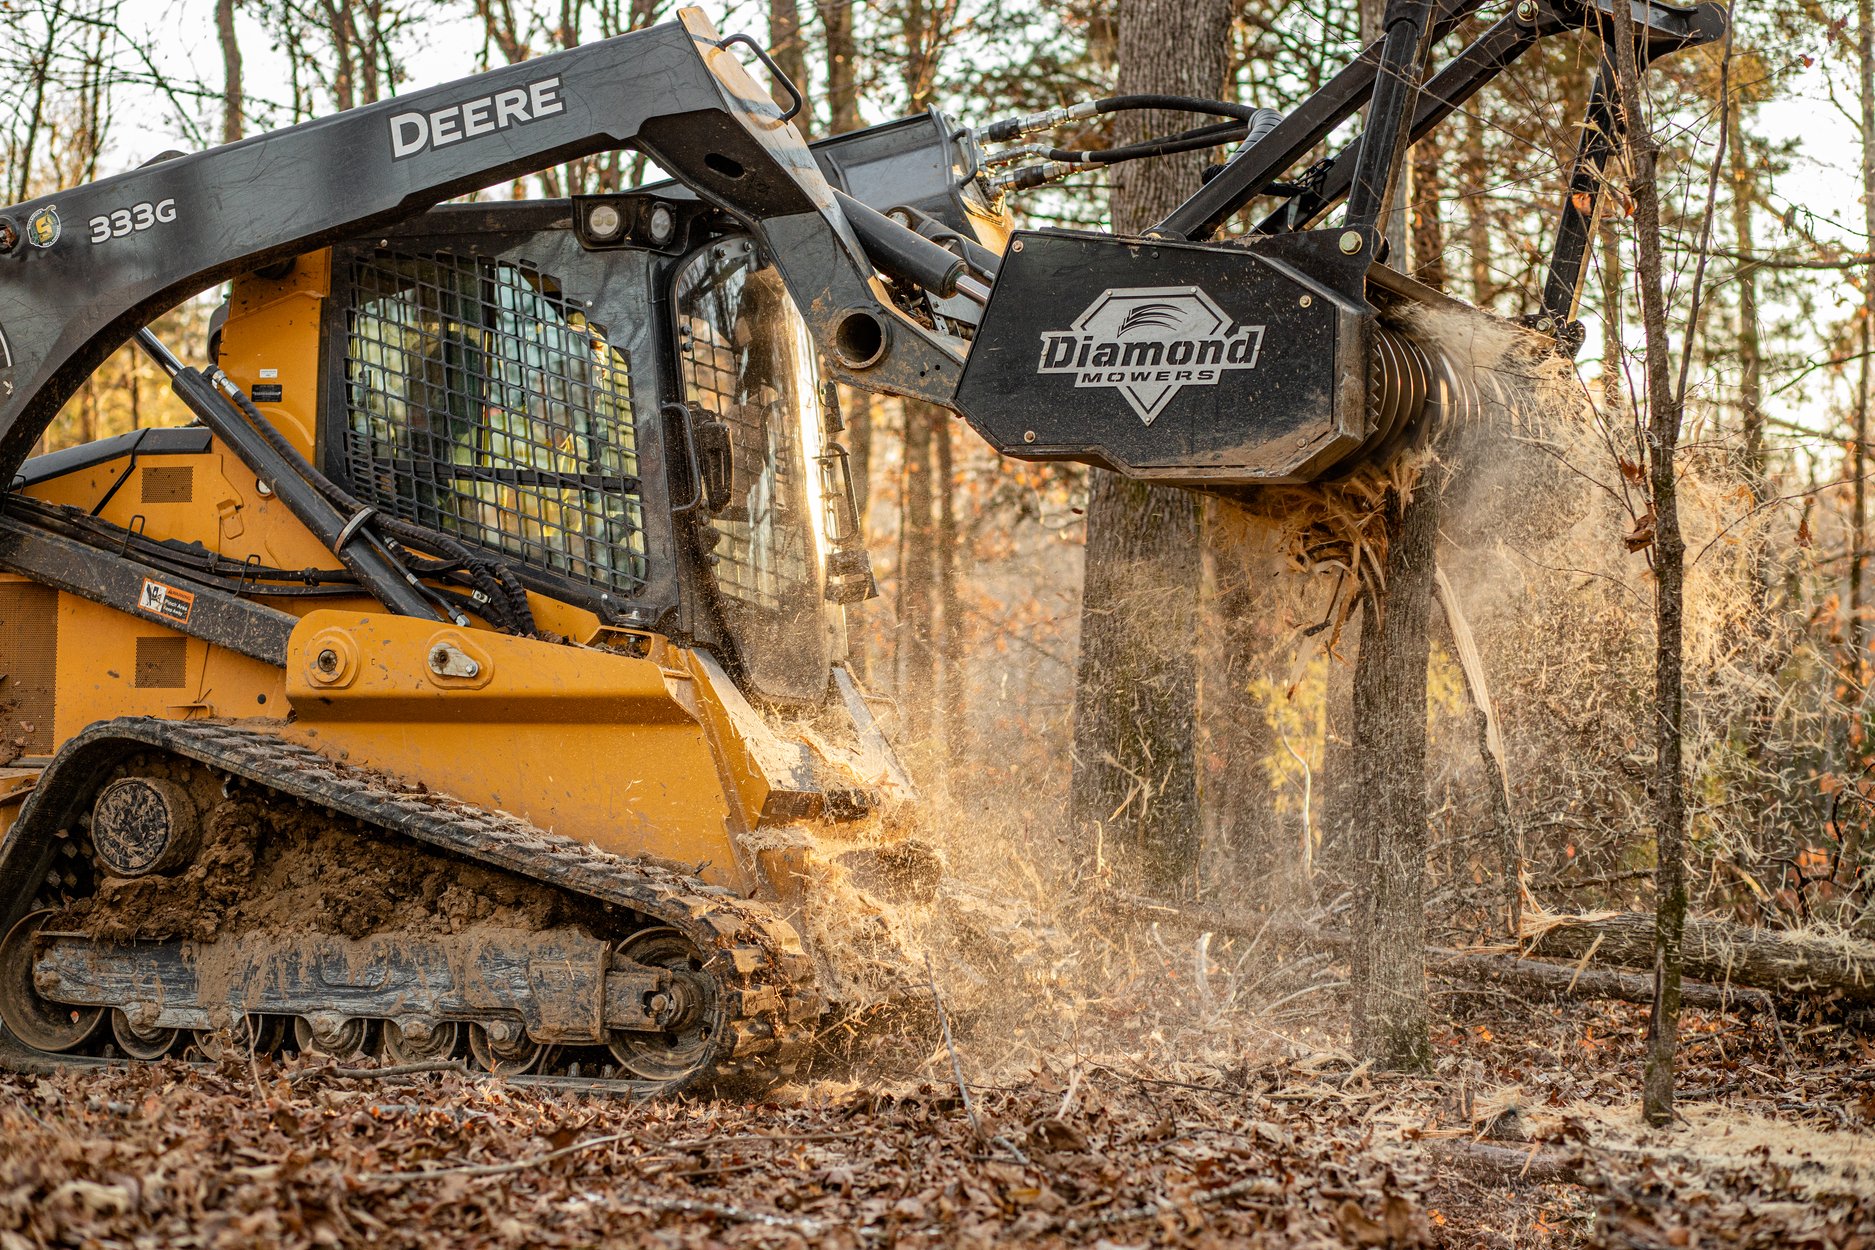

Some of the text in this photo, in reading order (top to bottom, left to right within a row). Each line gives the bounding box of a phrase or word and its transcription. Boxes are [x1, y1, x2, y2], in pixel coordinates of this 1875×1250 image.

[389, 77, 563, 158] DEERE
[89, 198, 177, 244] 333G
[1043, 330, 1259, 369] Diamond
[1081, 370, 1215, 384] MOWERS
